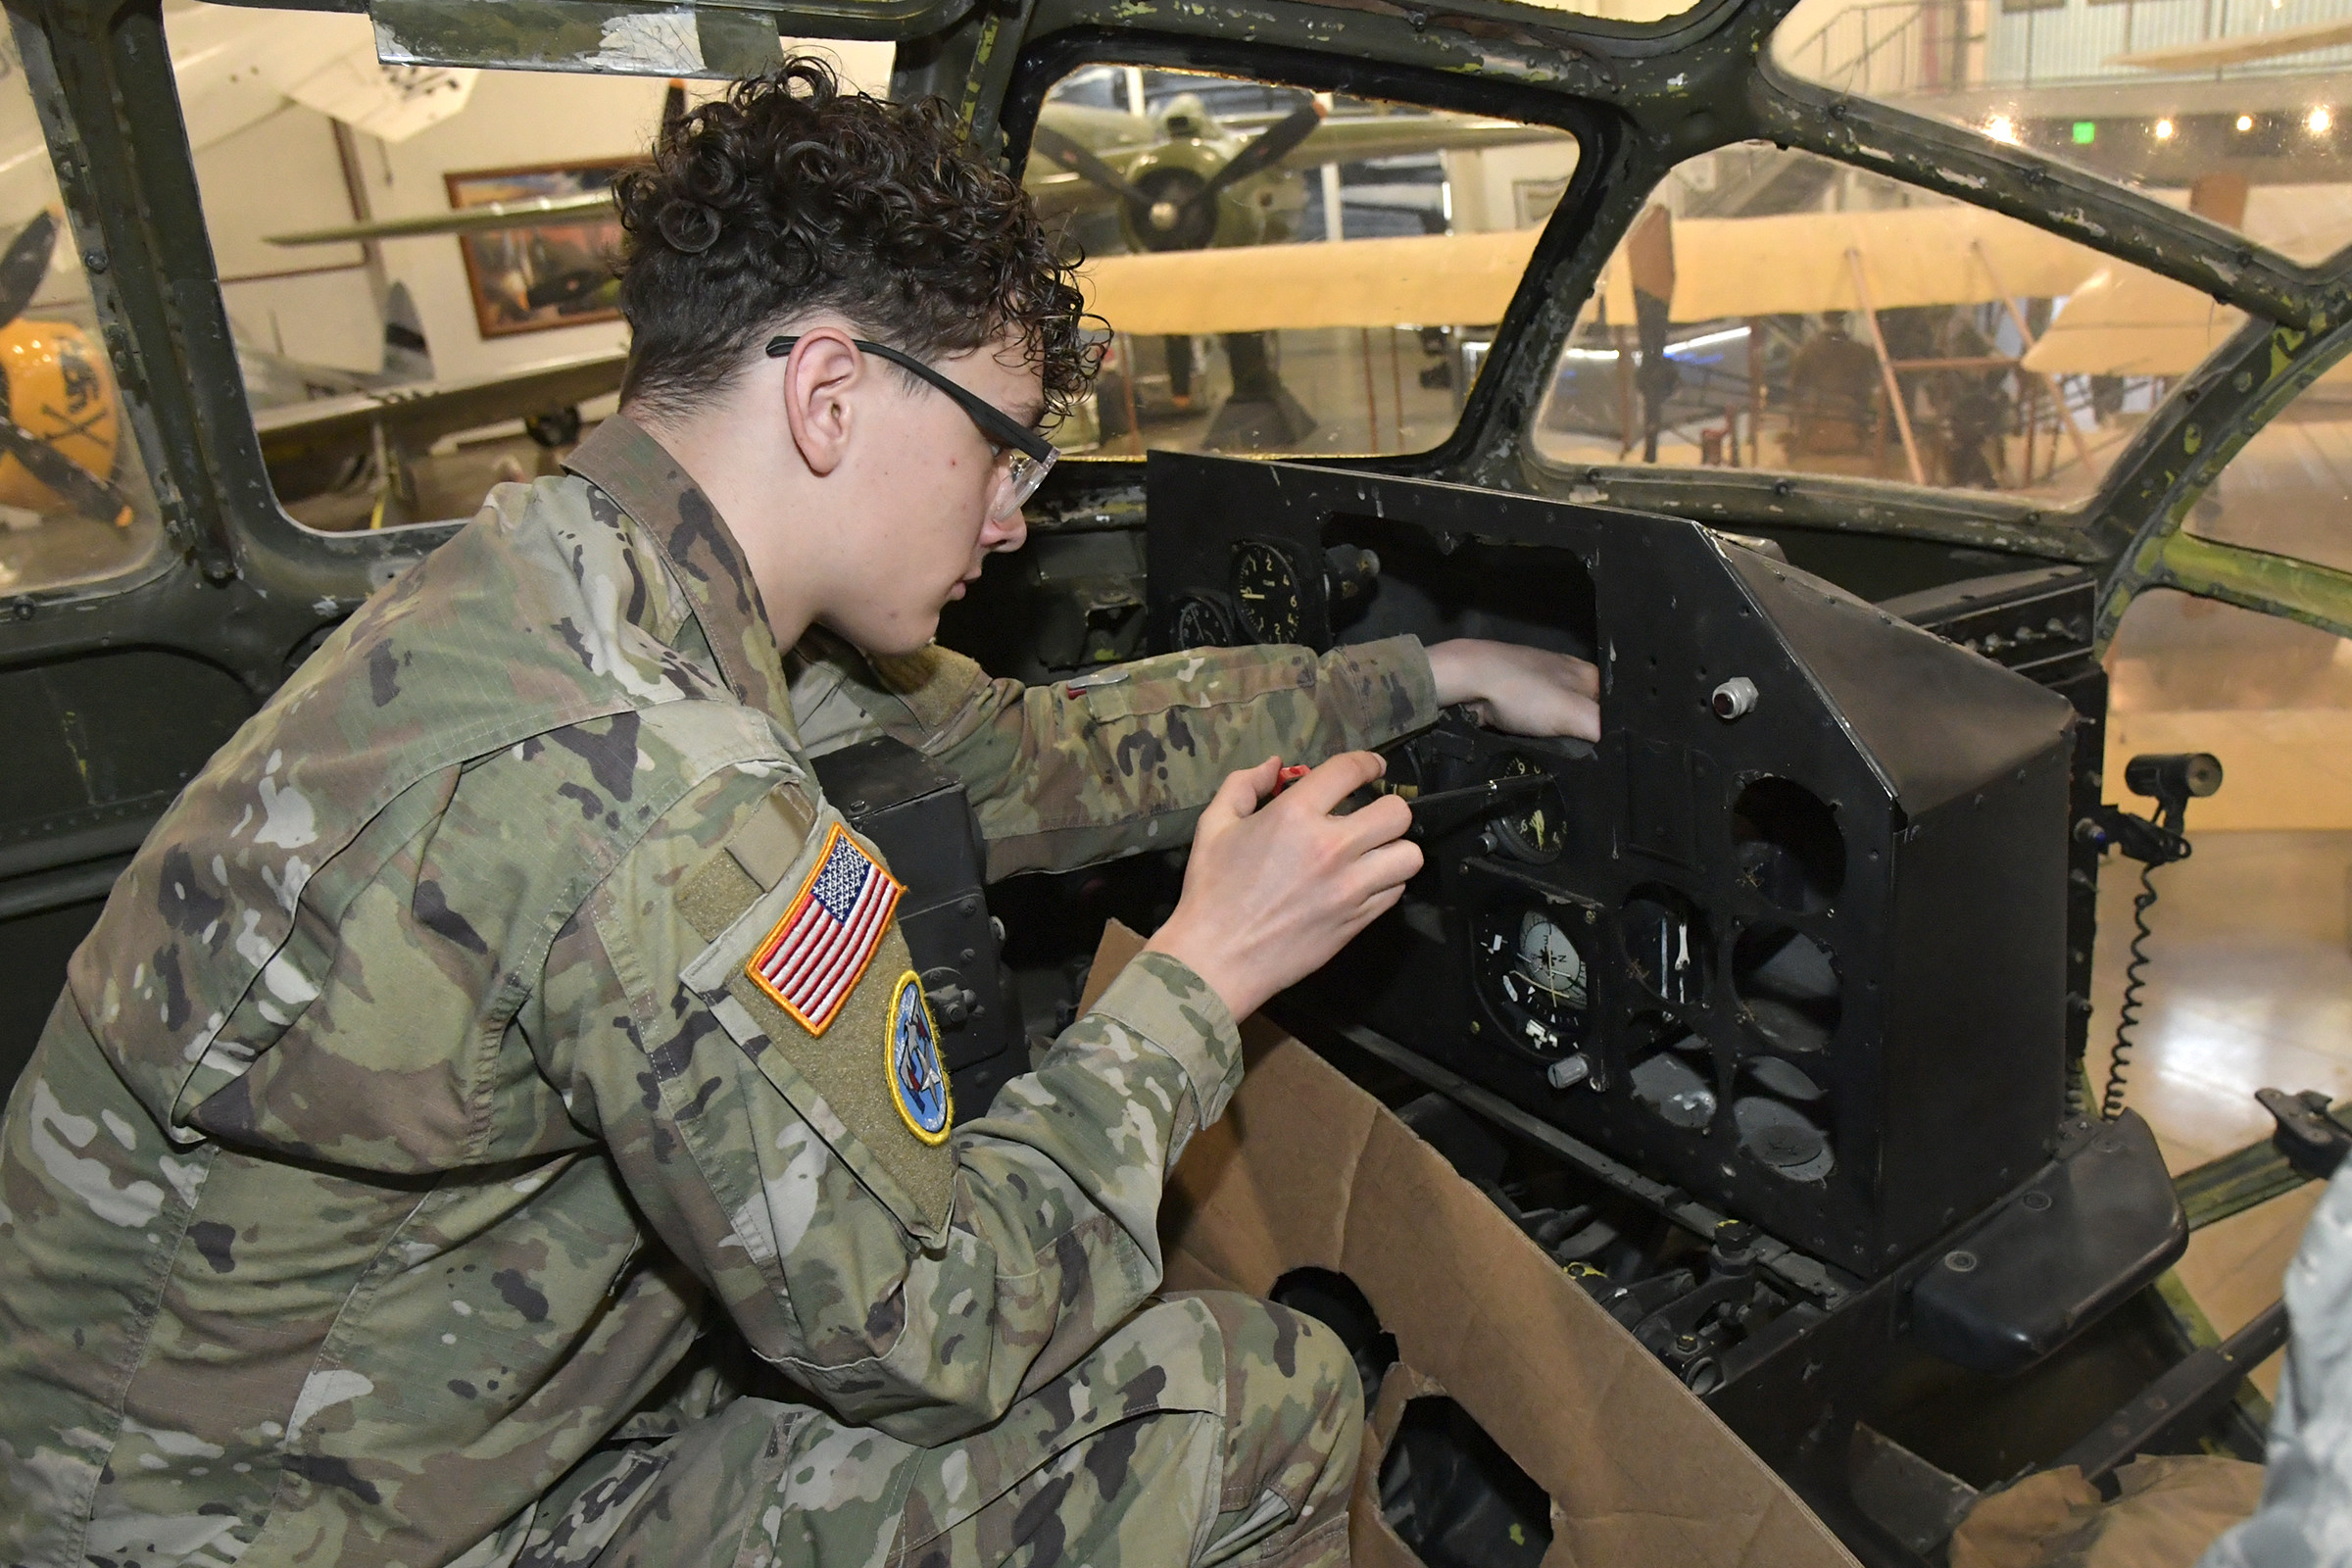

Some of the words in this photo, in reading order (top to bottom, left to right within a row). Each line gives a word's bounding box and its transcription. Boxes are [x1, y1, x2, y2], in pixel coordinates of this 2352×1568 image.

[1265, 559, 1273, 572] 2
[1290, 595, 1298, 608] 6
[1287, 612, 1295, 625] 4
[1273, 622, 1281, 635] 2
[1517, 761, 1526, 775] 9
[1520, 818, 1529, 832] 6
